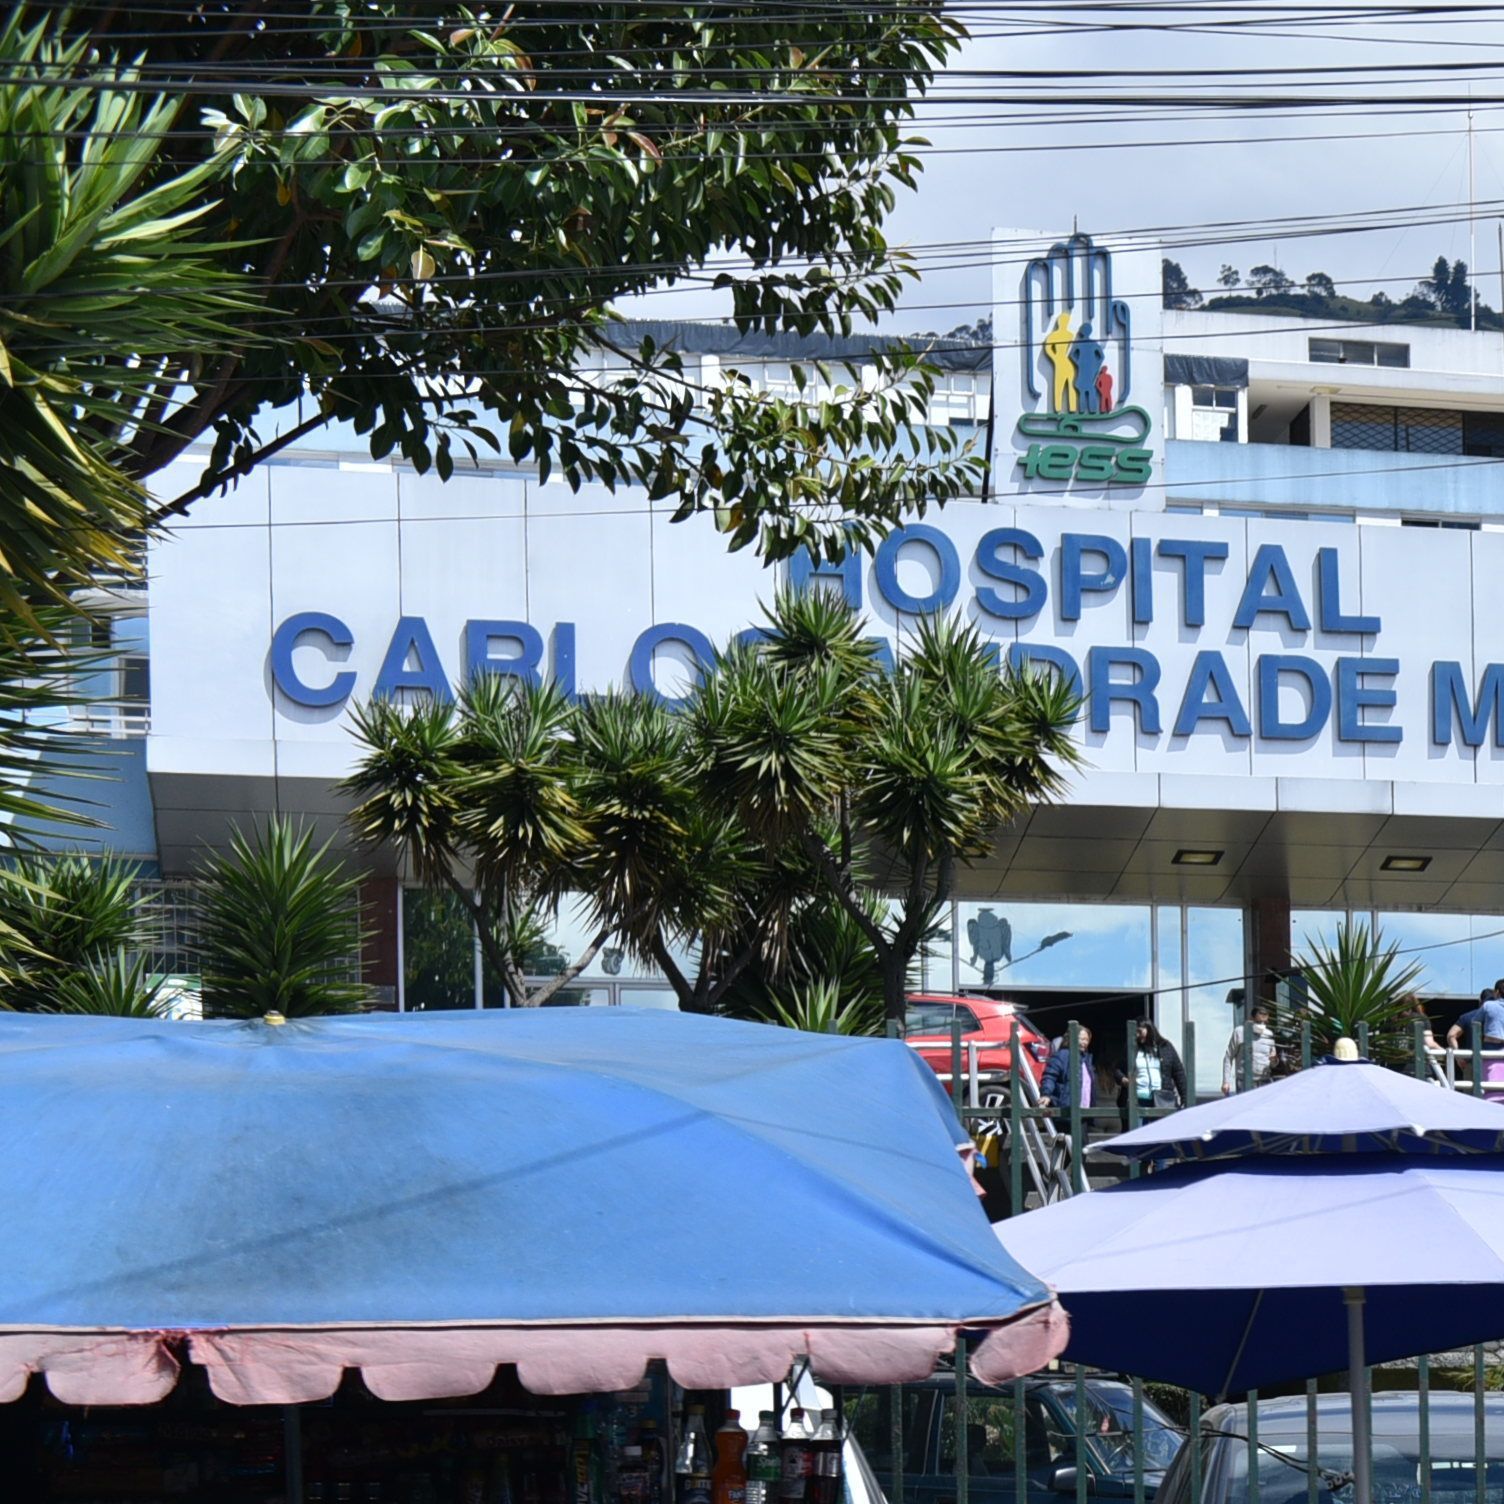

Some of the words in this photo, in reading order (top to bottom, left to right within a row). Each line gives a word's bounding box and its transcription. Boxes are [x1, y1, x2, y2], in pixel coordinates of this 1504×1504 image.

[787, 522, 1381, 634] HOSPITAL
[271, 611, 785, 716] CARLO
[862, 635, 1403, 743] DRADE
